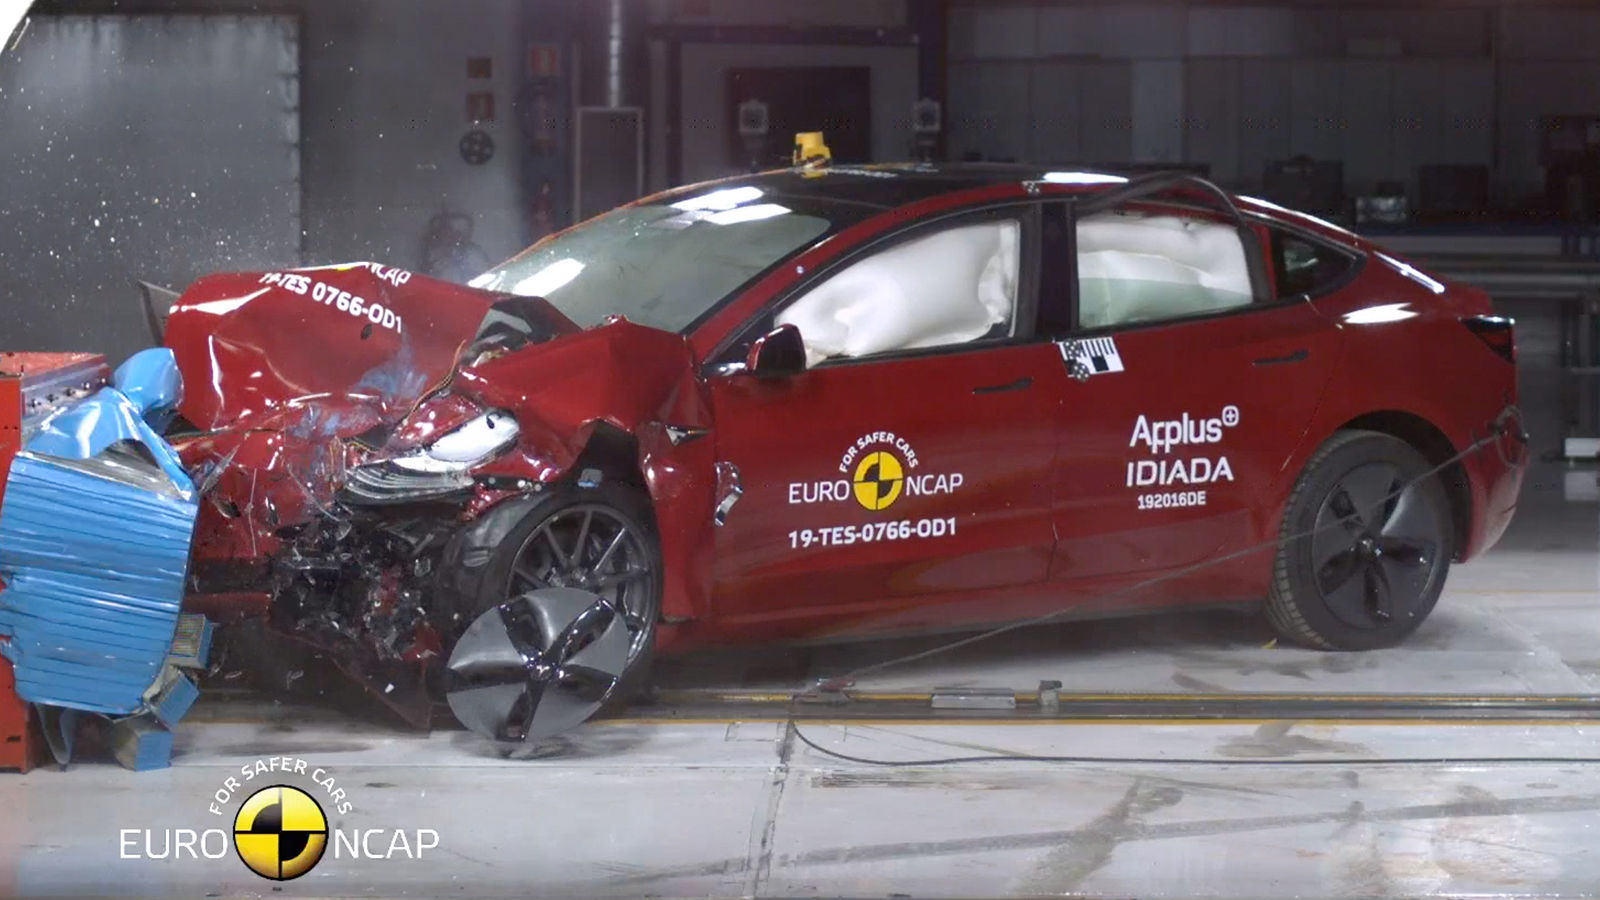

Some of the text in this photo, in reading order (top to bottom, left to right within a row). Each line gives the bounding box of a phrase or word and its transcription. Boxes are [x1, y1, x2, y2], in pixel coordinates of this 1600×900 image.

[1129, 412, 1223, 454] Applus
[839, 431, 918, 472] FOR SAFER CARS
[1127, 456, 1234, 487] IDIADA
[788, 473, 963, 503] EURO NCAP
[1138, 490, 1206, 509] 192016DE
[788, 517, 956, 548] 19-TES-0766-OD1
